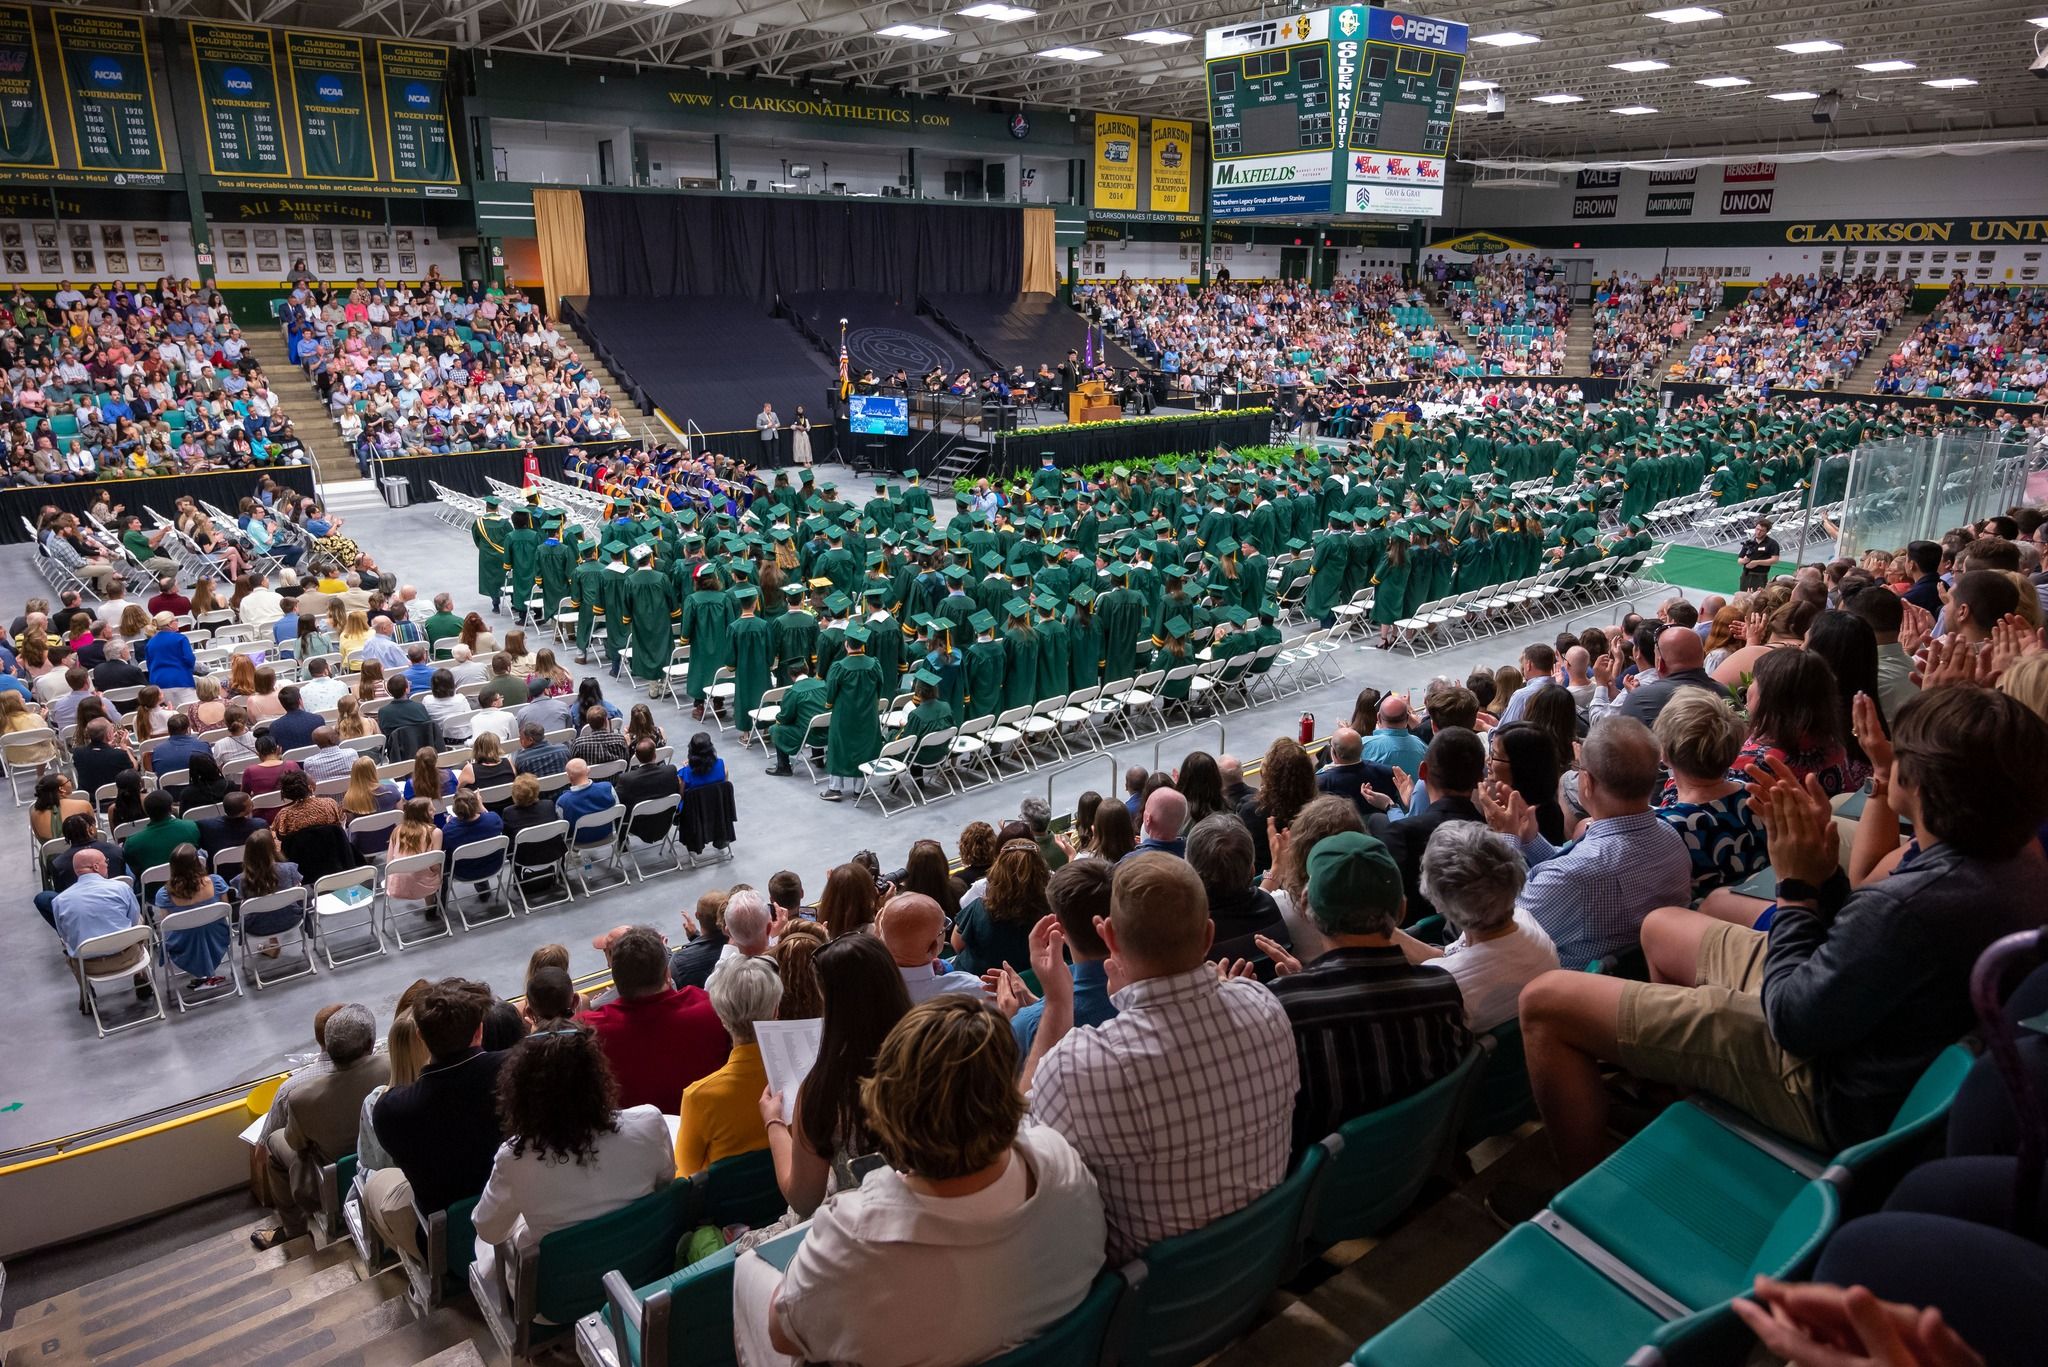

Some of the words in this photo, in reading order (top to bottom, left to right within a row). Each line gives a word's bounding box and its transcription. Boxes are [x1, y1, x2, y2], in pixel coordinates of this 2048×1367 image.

[74, 18, 124, 29] CLARKSON
[58, 24, 98, 34] GOLDEN
[99, 28, 141, 38] KNIGHTS
[208, 30, 254, 40] CLARKSON
[1405, 19, 1449, 46] PEPSI
[69, 38, 96, 48] MEN'S
[100, 41, 136, 51] HOCKEY
[195, 36, 232, 46] GOLDEN
[232, 39, 270, 49] KNIGHTS
[304, 39, 345, 49] CLARKSON
[290, 45, 324, 55] GOLDEN
[325, 48, 360, 58] KNIGHTS
[394, 48, 434, 58] CLARKSON
[230, 52, 264, 62] HOCKEY
[382, 54, 414, 64] GOLDEN
[323, 61, 354, 70] HOCKEY
[1338, 42, 1358, 90] GOLDEN
[94, 70, 122, 81] NCAA
[412, 70, 442, 78] HOCKEY
[227, 80, 253, 90] NCAA
[78, 89, 143, 100] TOURNAMENT
[320, 87, 344, 97] NCAA
[212, 98, 272, 109] TOURNAMENT
[408, 94, 430, 104] NCAA
[83, 104, 102, 112] 1957
[124, 108, 144, 116] 1970
[304, 104, 360, 115] TOURNAMENT
[669, 92, 712, 106] WWW
[922, 114, 950, 126] COM
[394, 111, 424, 120] FROZEN
[1338, 92, 1351, 148] KNIGHTS
[1098, 122, 1136, 140] CLARKSON
[1153, 127, 1190, 144] CLARKSON
[1356, 156, 1372, 165] NBT
[1388, 158, 1403, 167] NBT
[1418, 160, 1432, 169] NBT
[1360, 164, 1380, 174] BANK
[1392, 167, 1410, 176] BANK
[1422, 169, 1440, 178] BANK
[1726, 164, 1775, 176] RENSSELAER
[21, 172, 49, 181] Plastic
[57, 174, 78, 182] Glass
[1101, 173, 1132, 182] NATIONAL
[1216, 164, 1296, 186] MAXFIELDS
[1582, 170, 1618, 184] YALE
[1650, 168, 1696, 181] HARVARD
[1156, 176, 1186, 185] NATIONAL
[246, 182, 288, 190] recyclables
[1098, 182, 1135, 190] CHAMPIONS
[1153, 184, 1188, 193] CHAMPIONS
[1109, 192, 1124, 200] 2014
[1649, 200, 1692, 211] DARTMOUTH
[1722, 194, 1772, 210] UNION
[240, 200, 271, 218] All
[277, 199, 374, 220] American
[1575, 200, 1616, 215] BROWN
[294, 212, 320, 221] MEN
[1096, 211, 1126, 220] CLARKSON
[1126, 212, 1146, 220] MAKES
[1146, 212, 1152, 220] IT
[1152, 213, 1167, 221] EASY
[1785, 222, 1955, 242] CLARKSON
[1455, 242, 1480, 252] Knight
[42, 1338, 60, 1356] B
